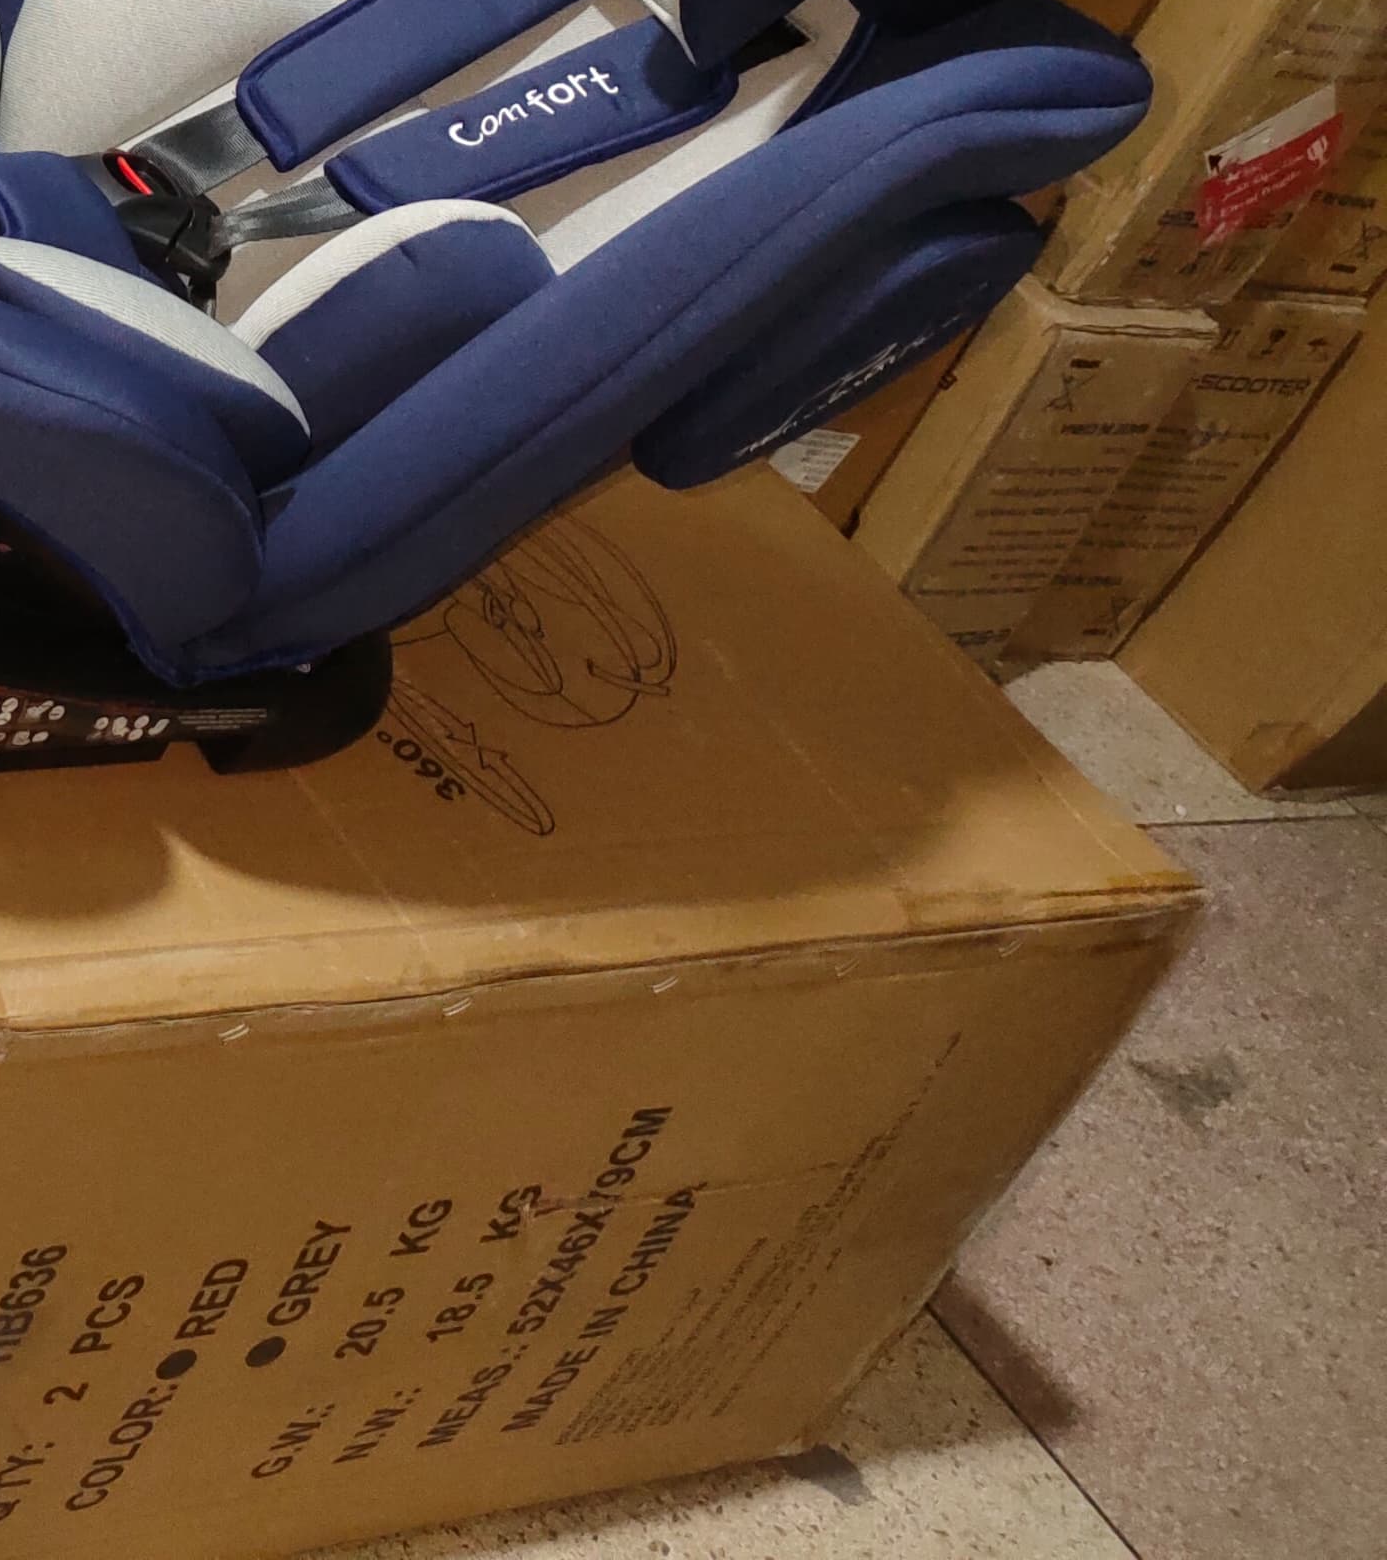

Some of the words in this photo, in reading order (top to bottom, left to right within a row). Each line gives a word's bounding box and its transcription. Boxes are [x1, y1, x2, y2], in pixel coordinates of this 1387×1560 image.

[447, 66, 619, 147] Confort
[44, 1381, 89, 1406] 2
[68, 1274, 146, 1356] PCS
[264, 1220, 354, 1328] GREY
[334, 1285, 406, 1361] 20.5
[389, 1198, 454, 1258] KG
[428, 1271, 494, 1345] 18.5
[481, 1183, 543, 1244] KG
[501, 1346, 600, 1432] MADE
[579, 1305, 629, 1339] IN
[610, 1182, 707, 1297] CHINA
[65, 1383, 179, 1513] COLOR:
[175, 1257, 251, 1341] RED
